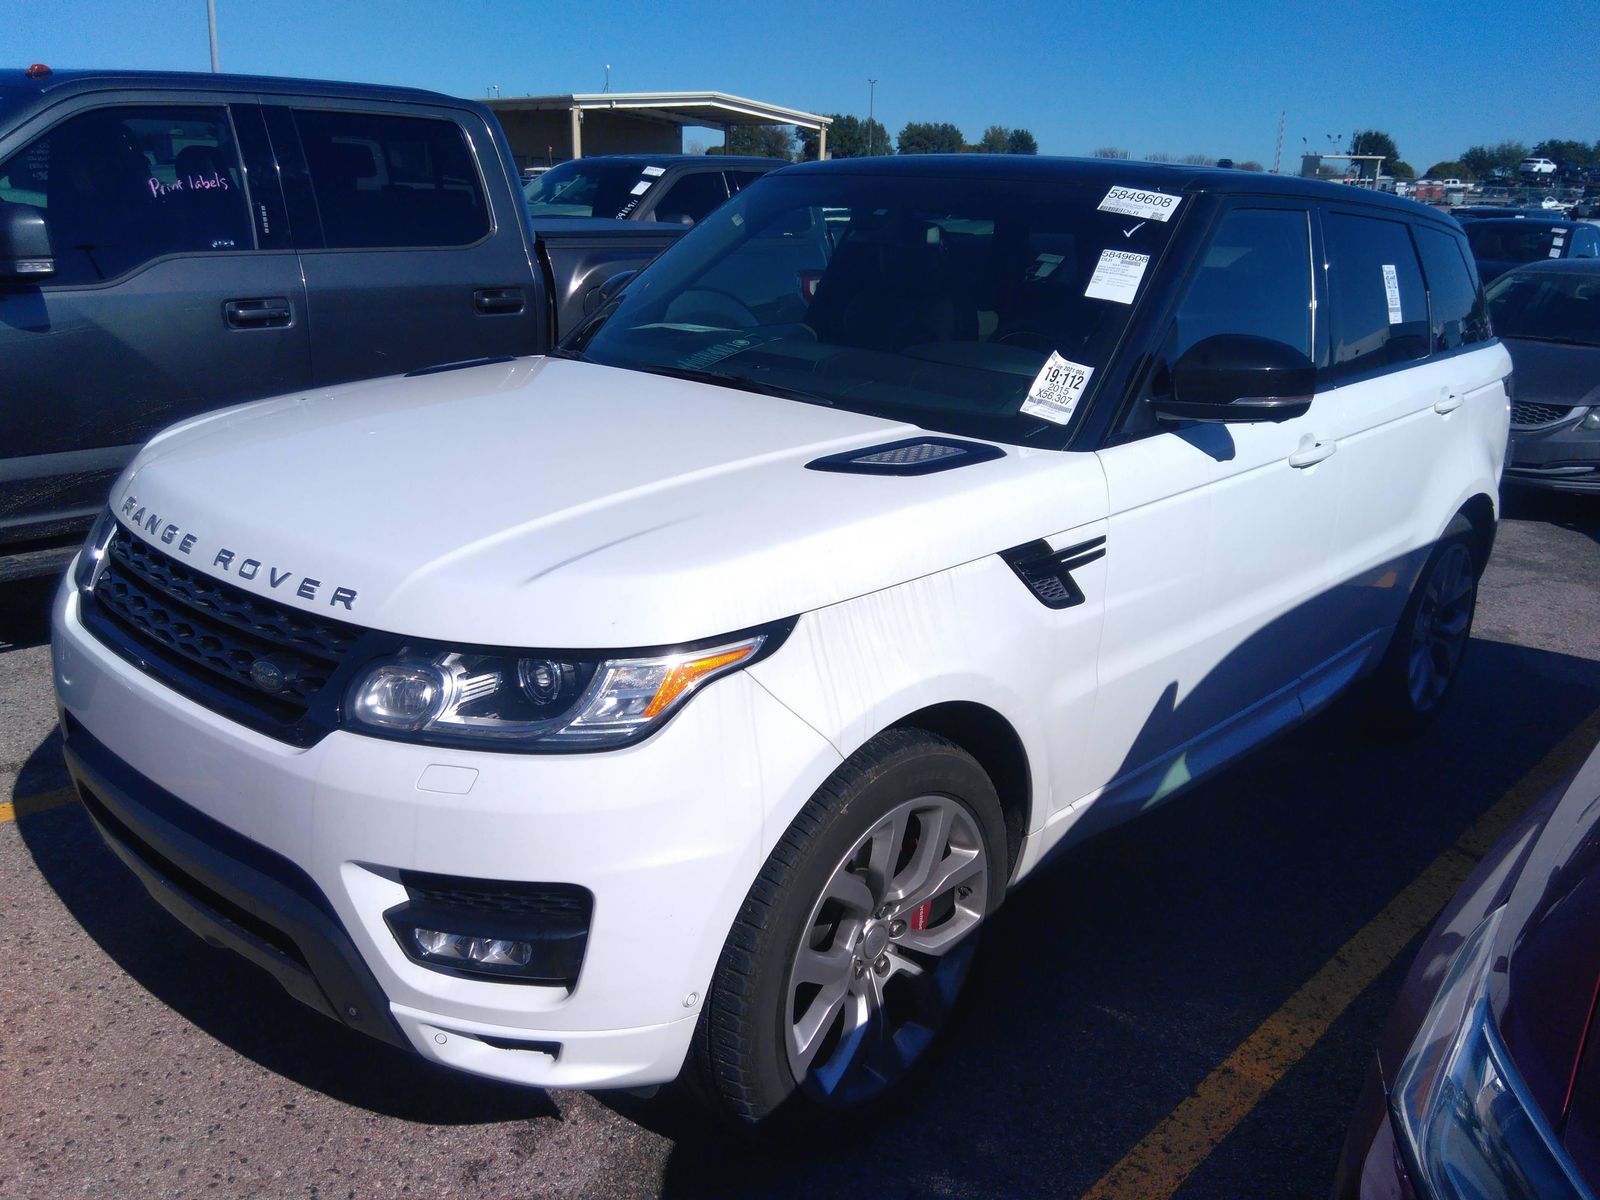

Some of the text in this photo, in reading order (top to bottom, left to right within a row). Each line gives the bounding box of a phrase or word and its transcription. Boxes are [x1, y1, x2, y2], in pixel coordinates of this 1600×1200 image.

[148, 172, 228, 198] Print labels
[1108, 188, 1172, 208] 5849608
[1102, 250, 1149, 263] 5849608
[1047, 383, 1070, 396] 2015
[121, 495, 359, 611] RANGE ROVER
